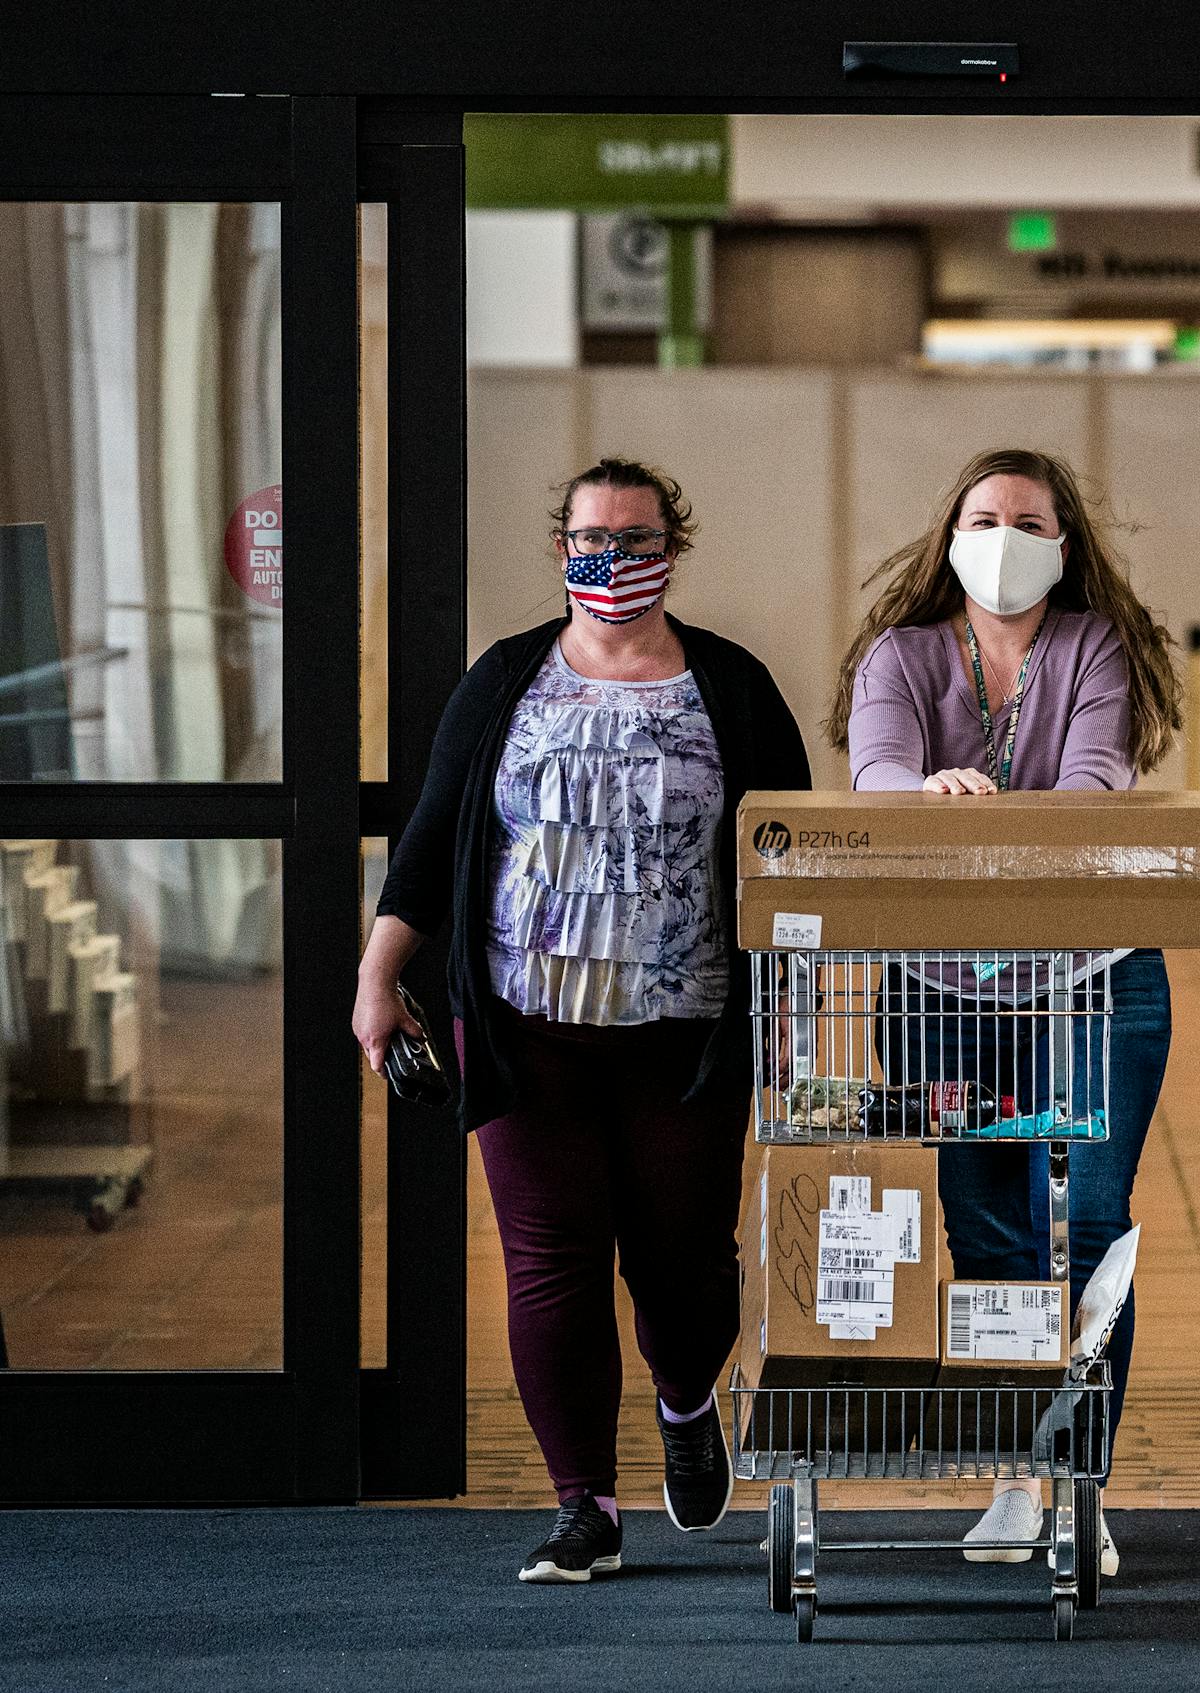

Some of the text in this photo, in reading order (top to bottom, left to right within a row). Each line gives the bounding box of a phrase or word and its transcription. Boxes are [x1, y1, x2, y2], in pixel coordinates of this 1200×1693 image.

[245, 510, 278, 528] DO
[271, 586, 282, 599] D
[758, 821, 788, 858] hp
[799, 831, 869, 848] P27h G4
